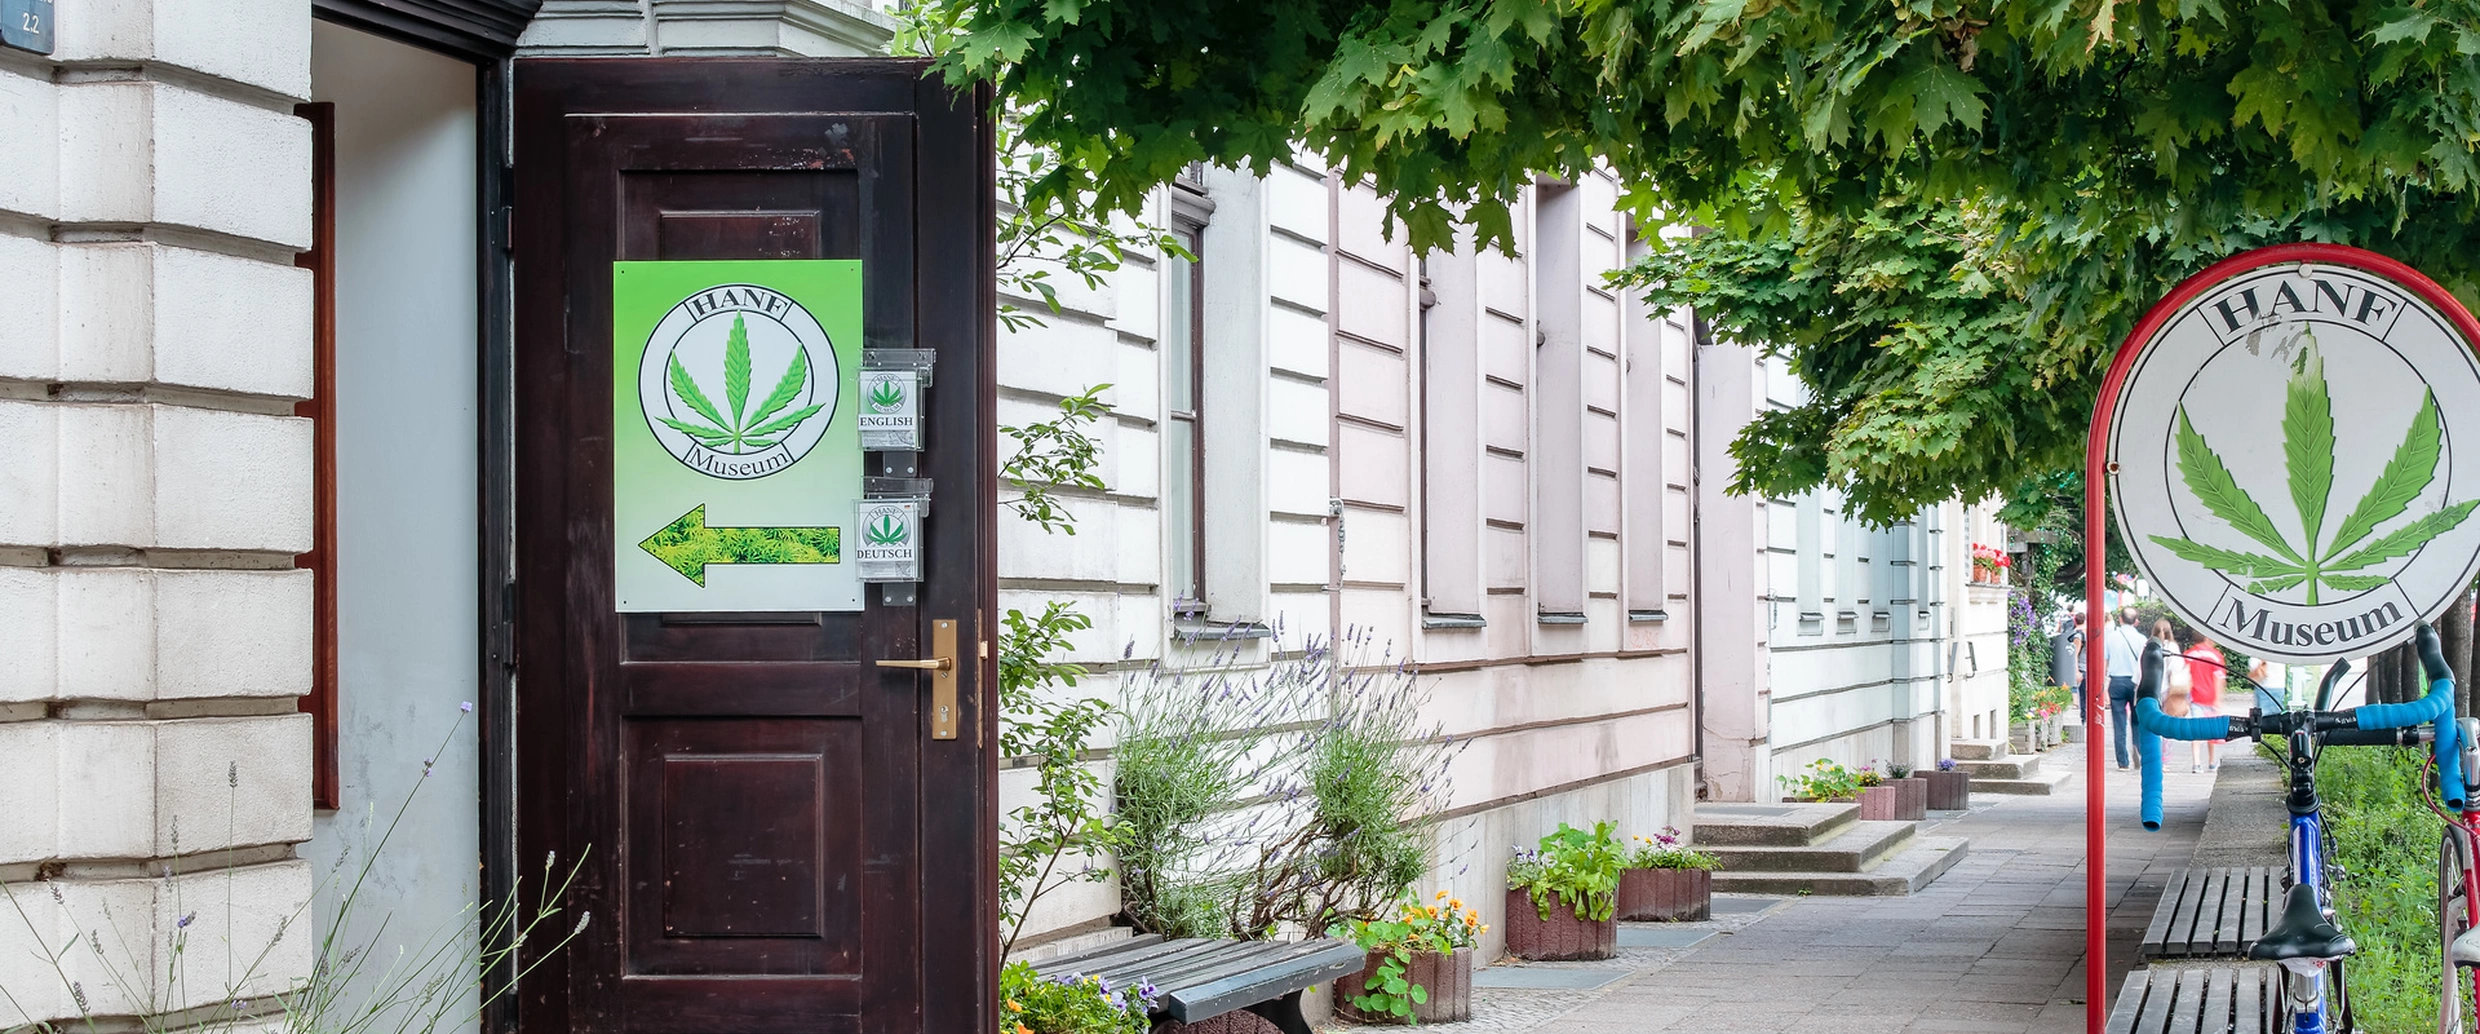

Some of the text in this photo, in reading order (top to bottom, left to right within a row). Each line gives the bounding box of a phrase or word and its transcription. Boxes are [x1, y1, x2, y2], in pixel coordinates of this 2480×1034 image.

[690, 288, 788, 316] HANF
[2210, 279, 2397, 336] HANF
[860, 417, 913, 426] ENGLISH
[688, 446, 789, 476] Museum
[857, 549, 912, 559] DEUTSCH
[2217, 596, 2405, 647] Museum
